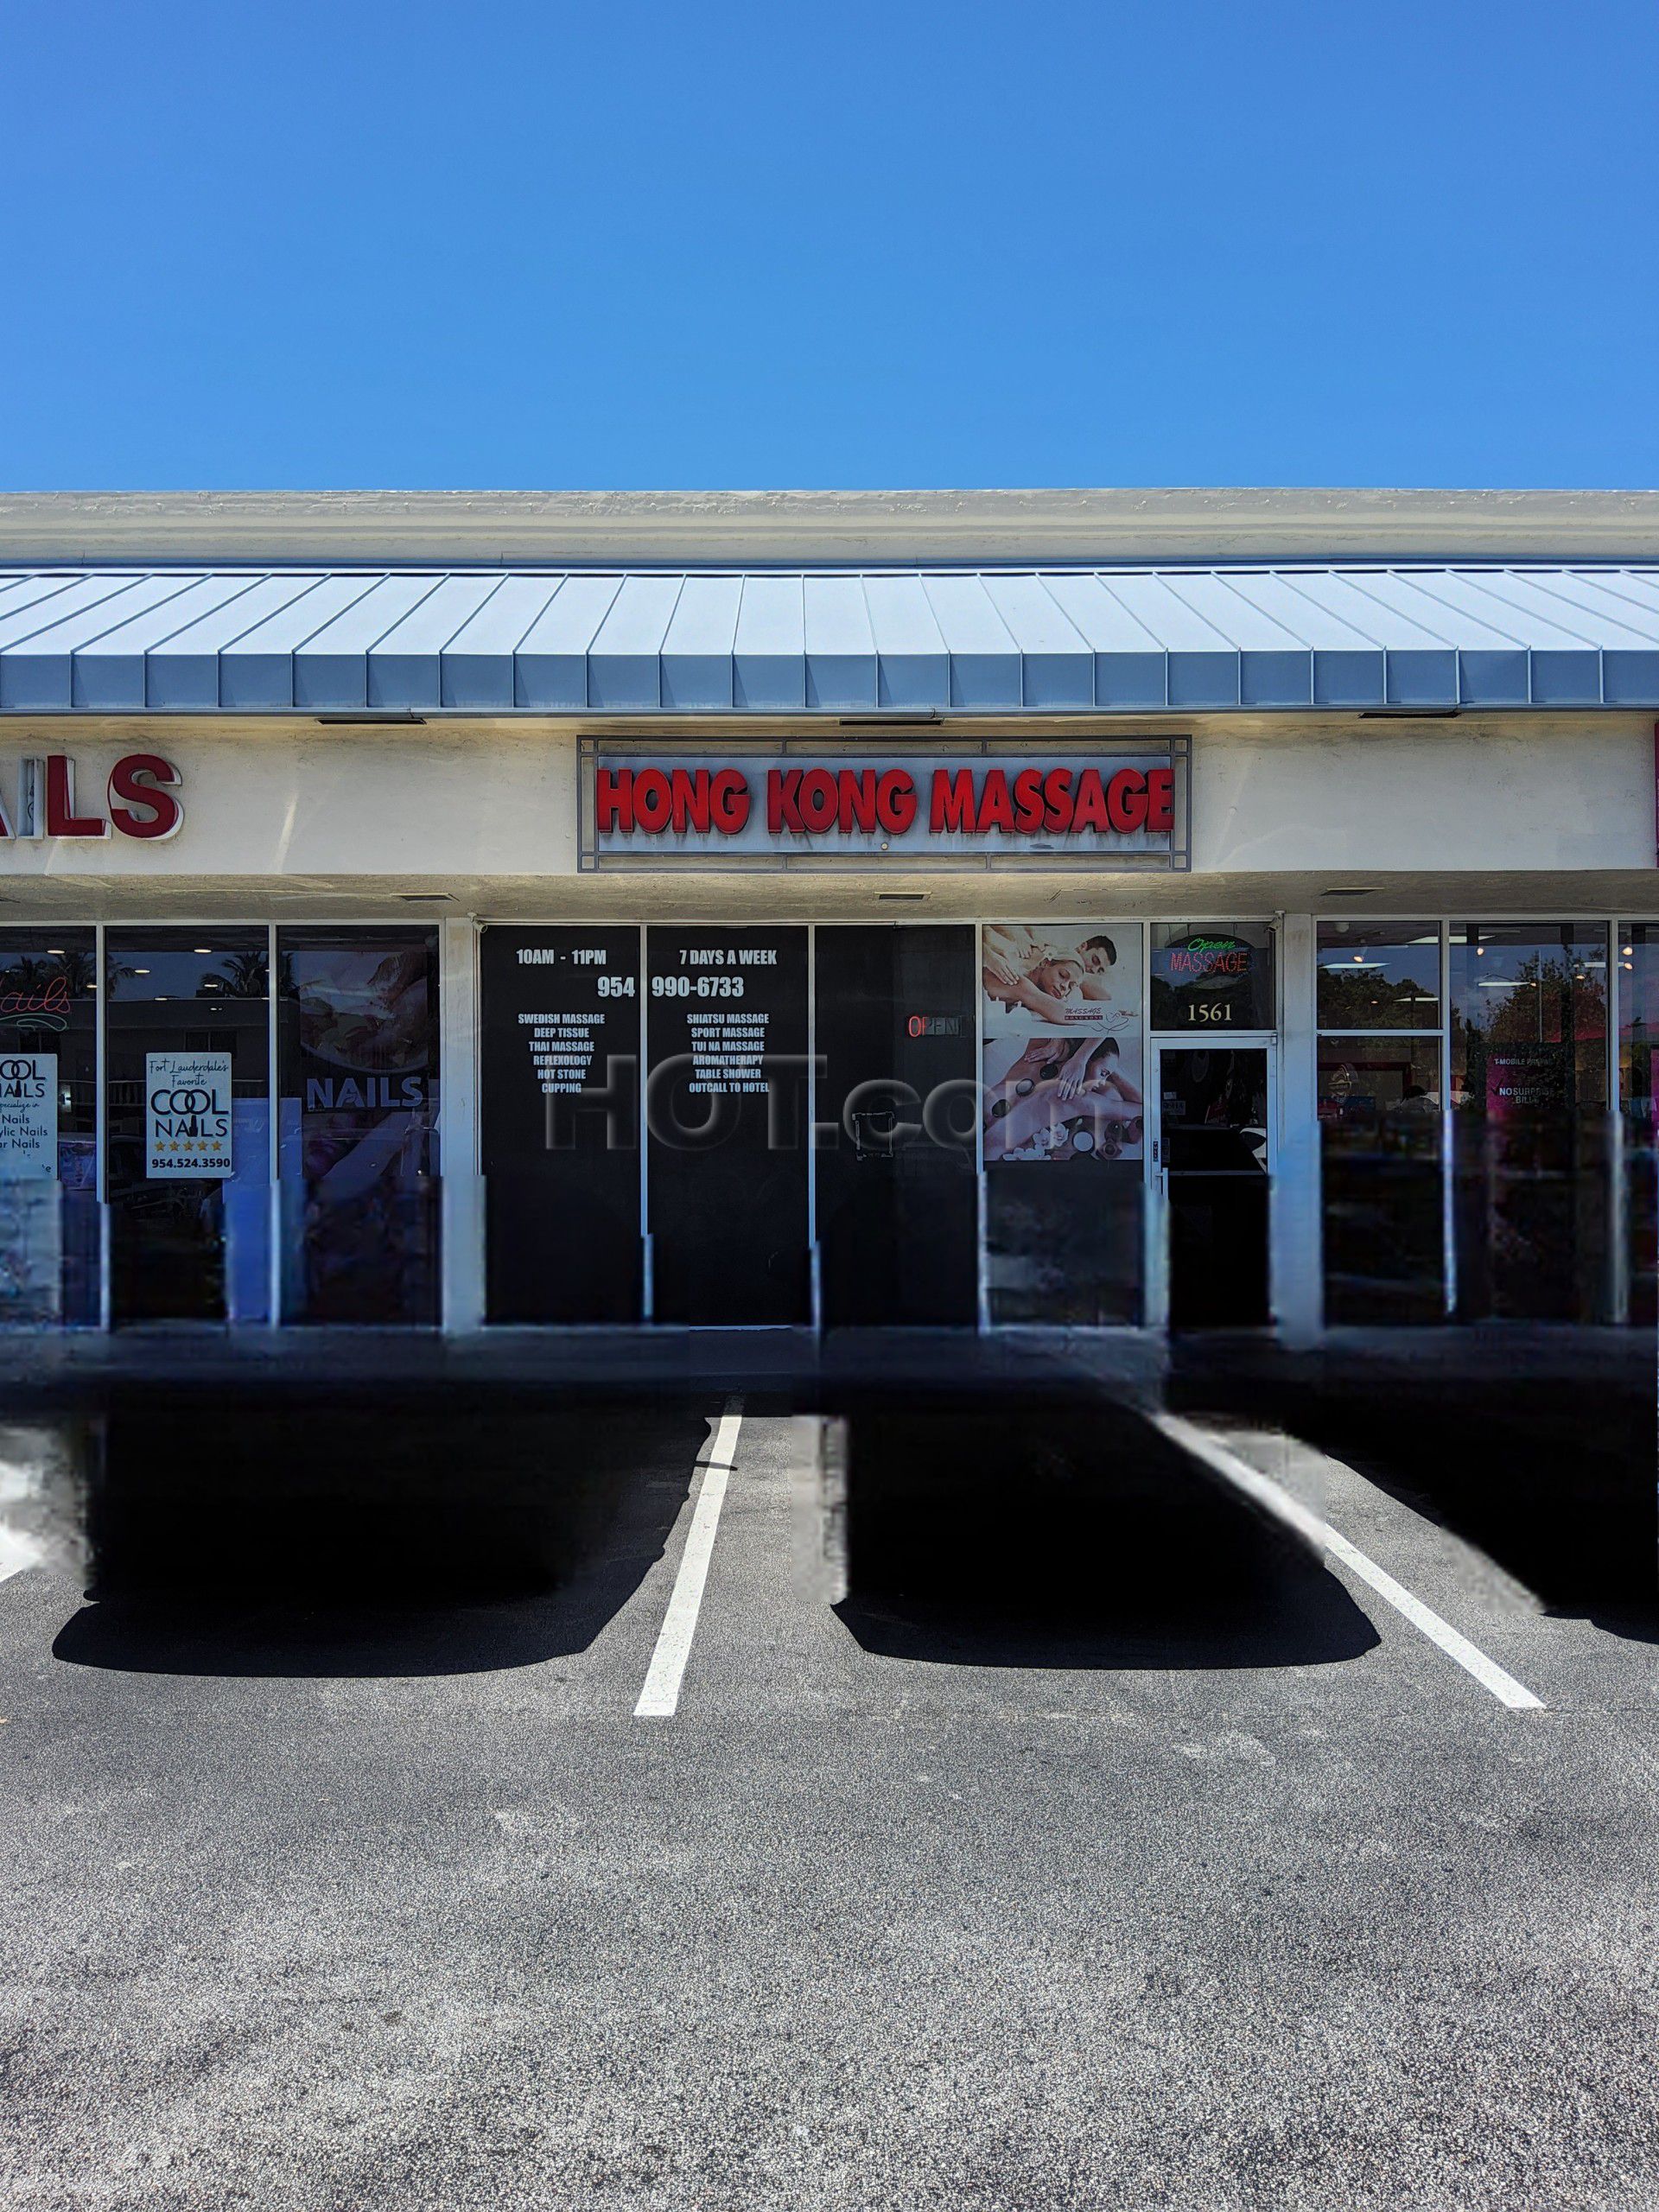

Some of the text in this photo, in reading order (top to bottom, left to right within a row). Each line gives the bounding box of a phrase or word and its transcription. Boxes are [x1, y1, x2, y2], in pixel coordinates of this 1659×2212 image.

[0, 753, 184, 841] ILS
[596, 768, 1174, 835] HONG KONG MASSAGE
[1188, 938, 1236, 952] Open
[516, 949, 555, 964] 10AM
[571, 950, 607, 965] 11PM
[679, 950, 778, 965] 7 DAYS A WEEK
[1170, 951, 1248, 974] MASSAGE
[597, 976, 744, 997] 954 990-6733
[0, 974, 71, 1014] ails
[1188, 1002, 1232, 1022] 1561
[518, 1014, 605, 1024] SWEDISH MASSAGE
[687, 1014, 769, 1024] SHIATSU MASSAGE
[534, 1027, 589, 1038] DEEP TISSUE
[691, 1027, 765, 1038] SPORT MASSAGE
[529, 1041, 594, 1052] THAI MASSAGE
[691, 1041, 765, 1052] TUI NA MASSAGE
[149, 1058, 229, 1073] Fort Lauderdale's
[533, 1055, 592, 1065] REFLEXOLOGY
[692, 1055, 764, 1065] AROMATHERAPY
[0, 1059, 47, 1080] OOL
[537, 1069, 586, 1079] HOT STONE
[695, 1069, 761, 1079] TABLE SHOWER
[172, 1072, 207, 1088] Favorite
[307, 1077, 423, 1108] NAILS
[542, 1084, 582, 1093] CUPPING
[689, 1083, 770, 1093] OUTCALL TO HOTEL
[0, 1100, 31, 1113] pecialize
[150, 1089, 229, 1115] COOL
[2, 1113, 30, 1124] Nails
[0, 1125, 48, 1138] ylic Nails
[156, 1115, 227, 1137] NAILS
[12, 1138, 41, 1149] Nails
[152, 1158, 230, 1168] 954.524.3590
